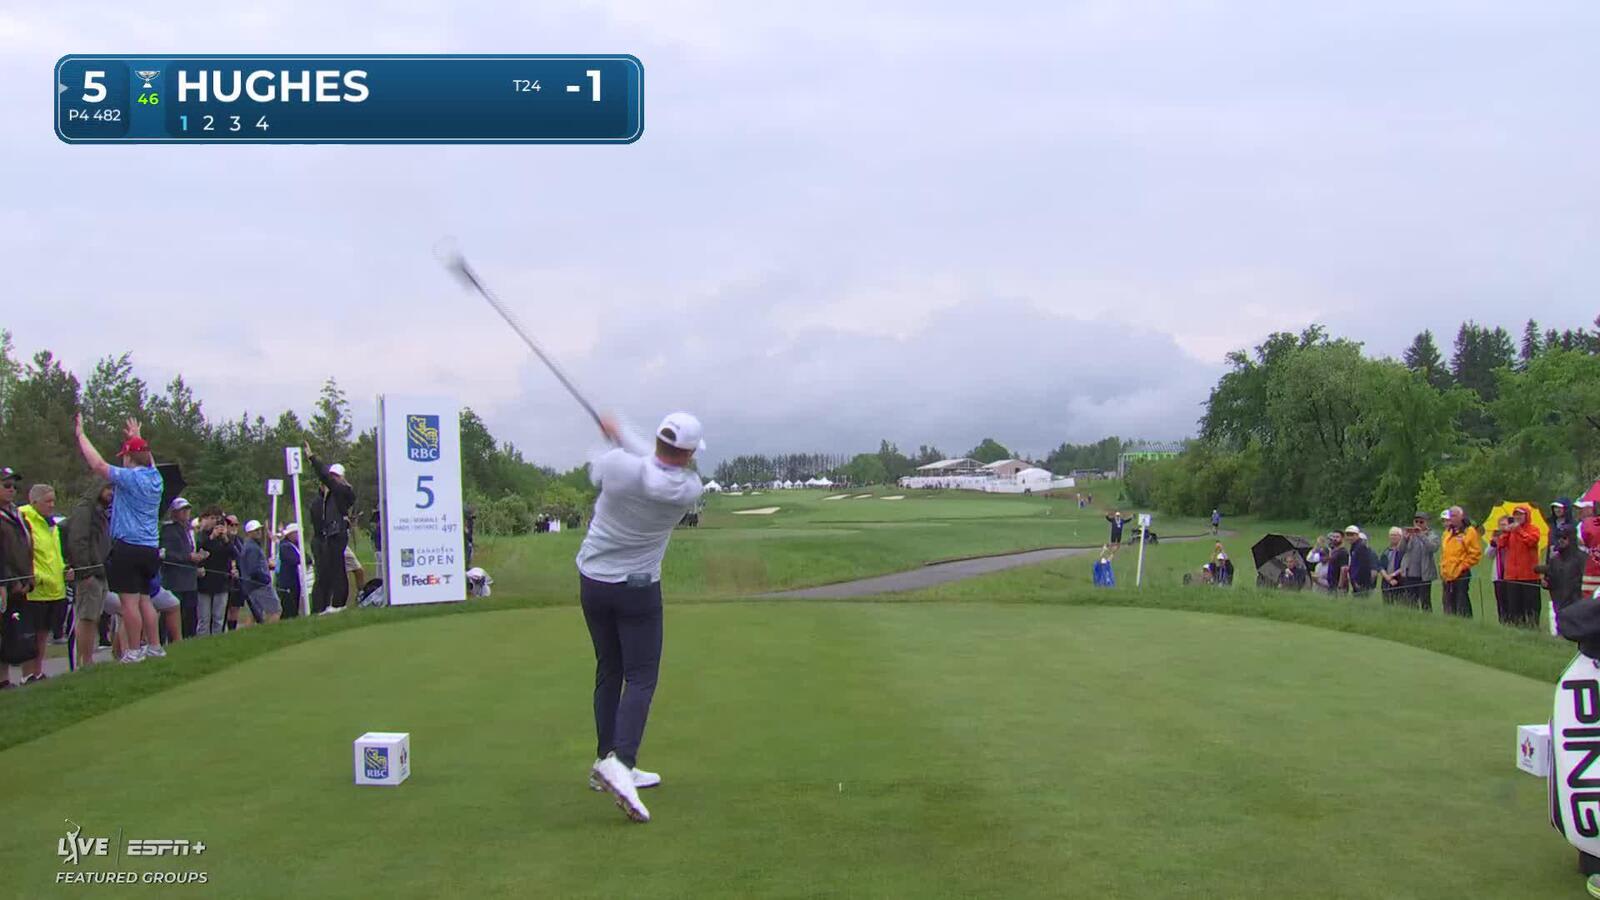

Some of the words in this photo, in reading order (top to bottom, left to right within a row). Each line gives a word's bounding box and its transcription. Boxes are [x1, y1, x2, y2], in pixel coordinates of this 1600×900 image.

[410, 448, 438, 459] RBC
[293, 452, 300, 470] 5
[415, 475, 434, 509] 5
[416, 555, 454, 566] OPEN
[411, 574, 441, 586] FedEx
[1562, 679, 1600, 838] PING
[367, 769, 387, 778] RBC
